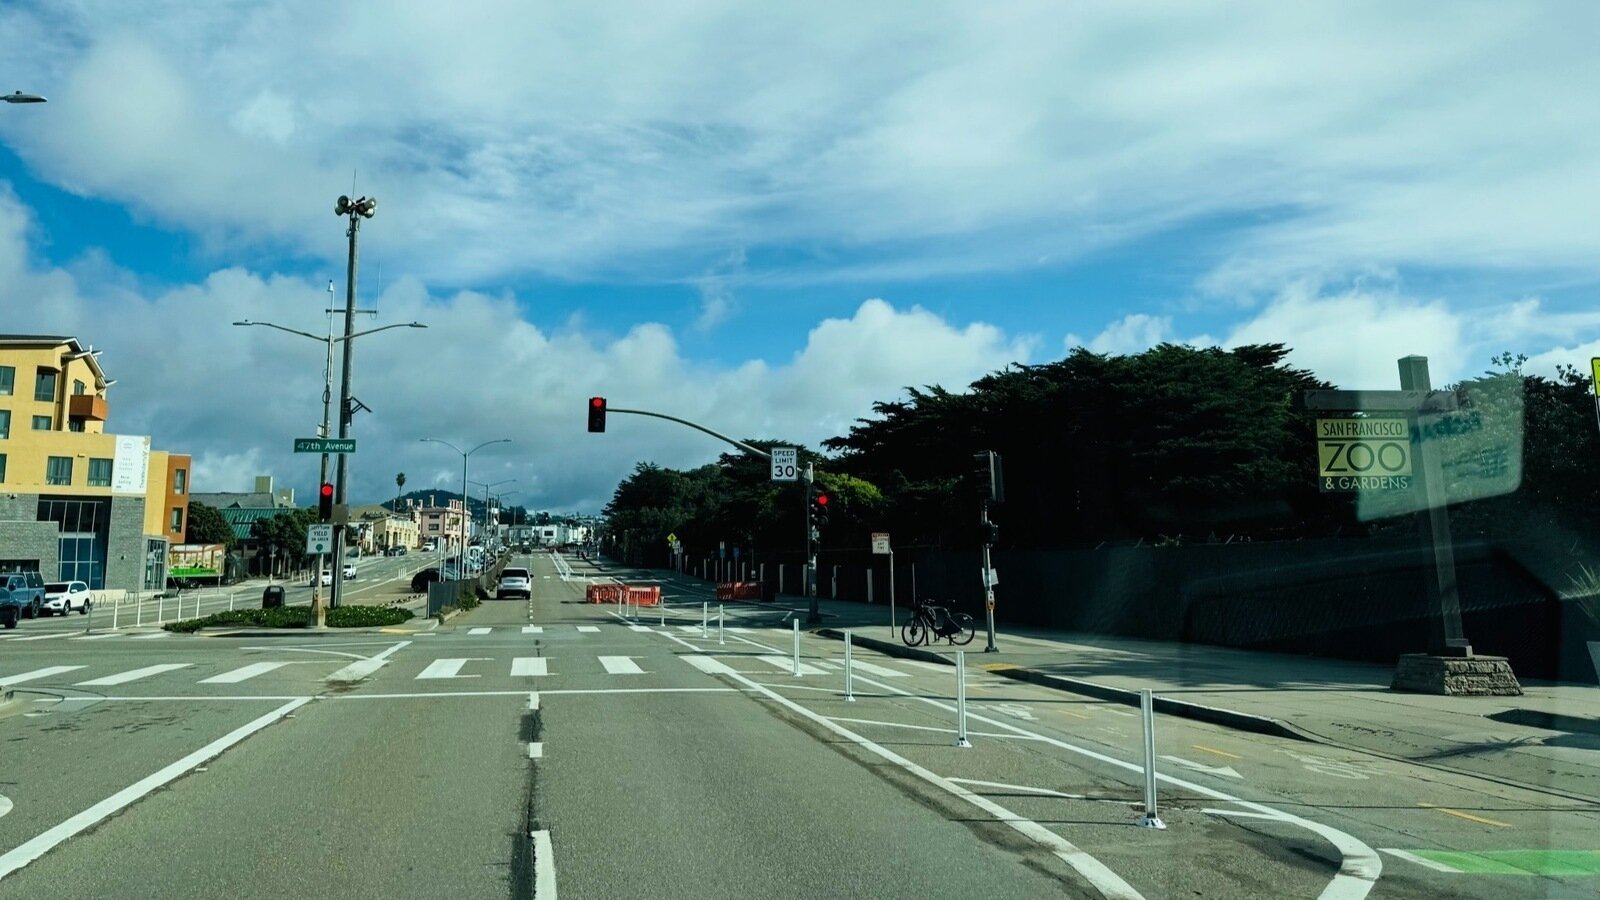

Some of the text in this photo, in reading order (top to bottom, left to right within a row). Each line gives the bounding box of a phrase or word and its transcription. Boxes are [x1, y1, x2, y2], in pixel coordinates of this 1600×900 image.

[1323, 422, 1403, 436] SAN FRANCISCO
[297, 441, 354, 450] 47th Avenue
[1324, 442, 1406, 472] ZOO
[774, 465, 795, 477] 30
[1325, 477, 1408, 489] & GARDENS
